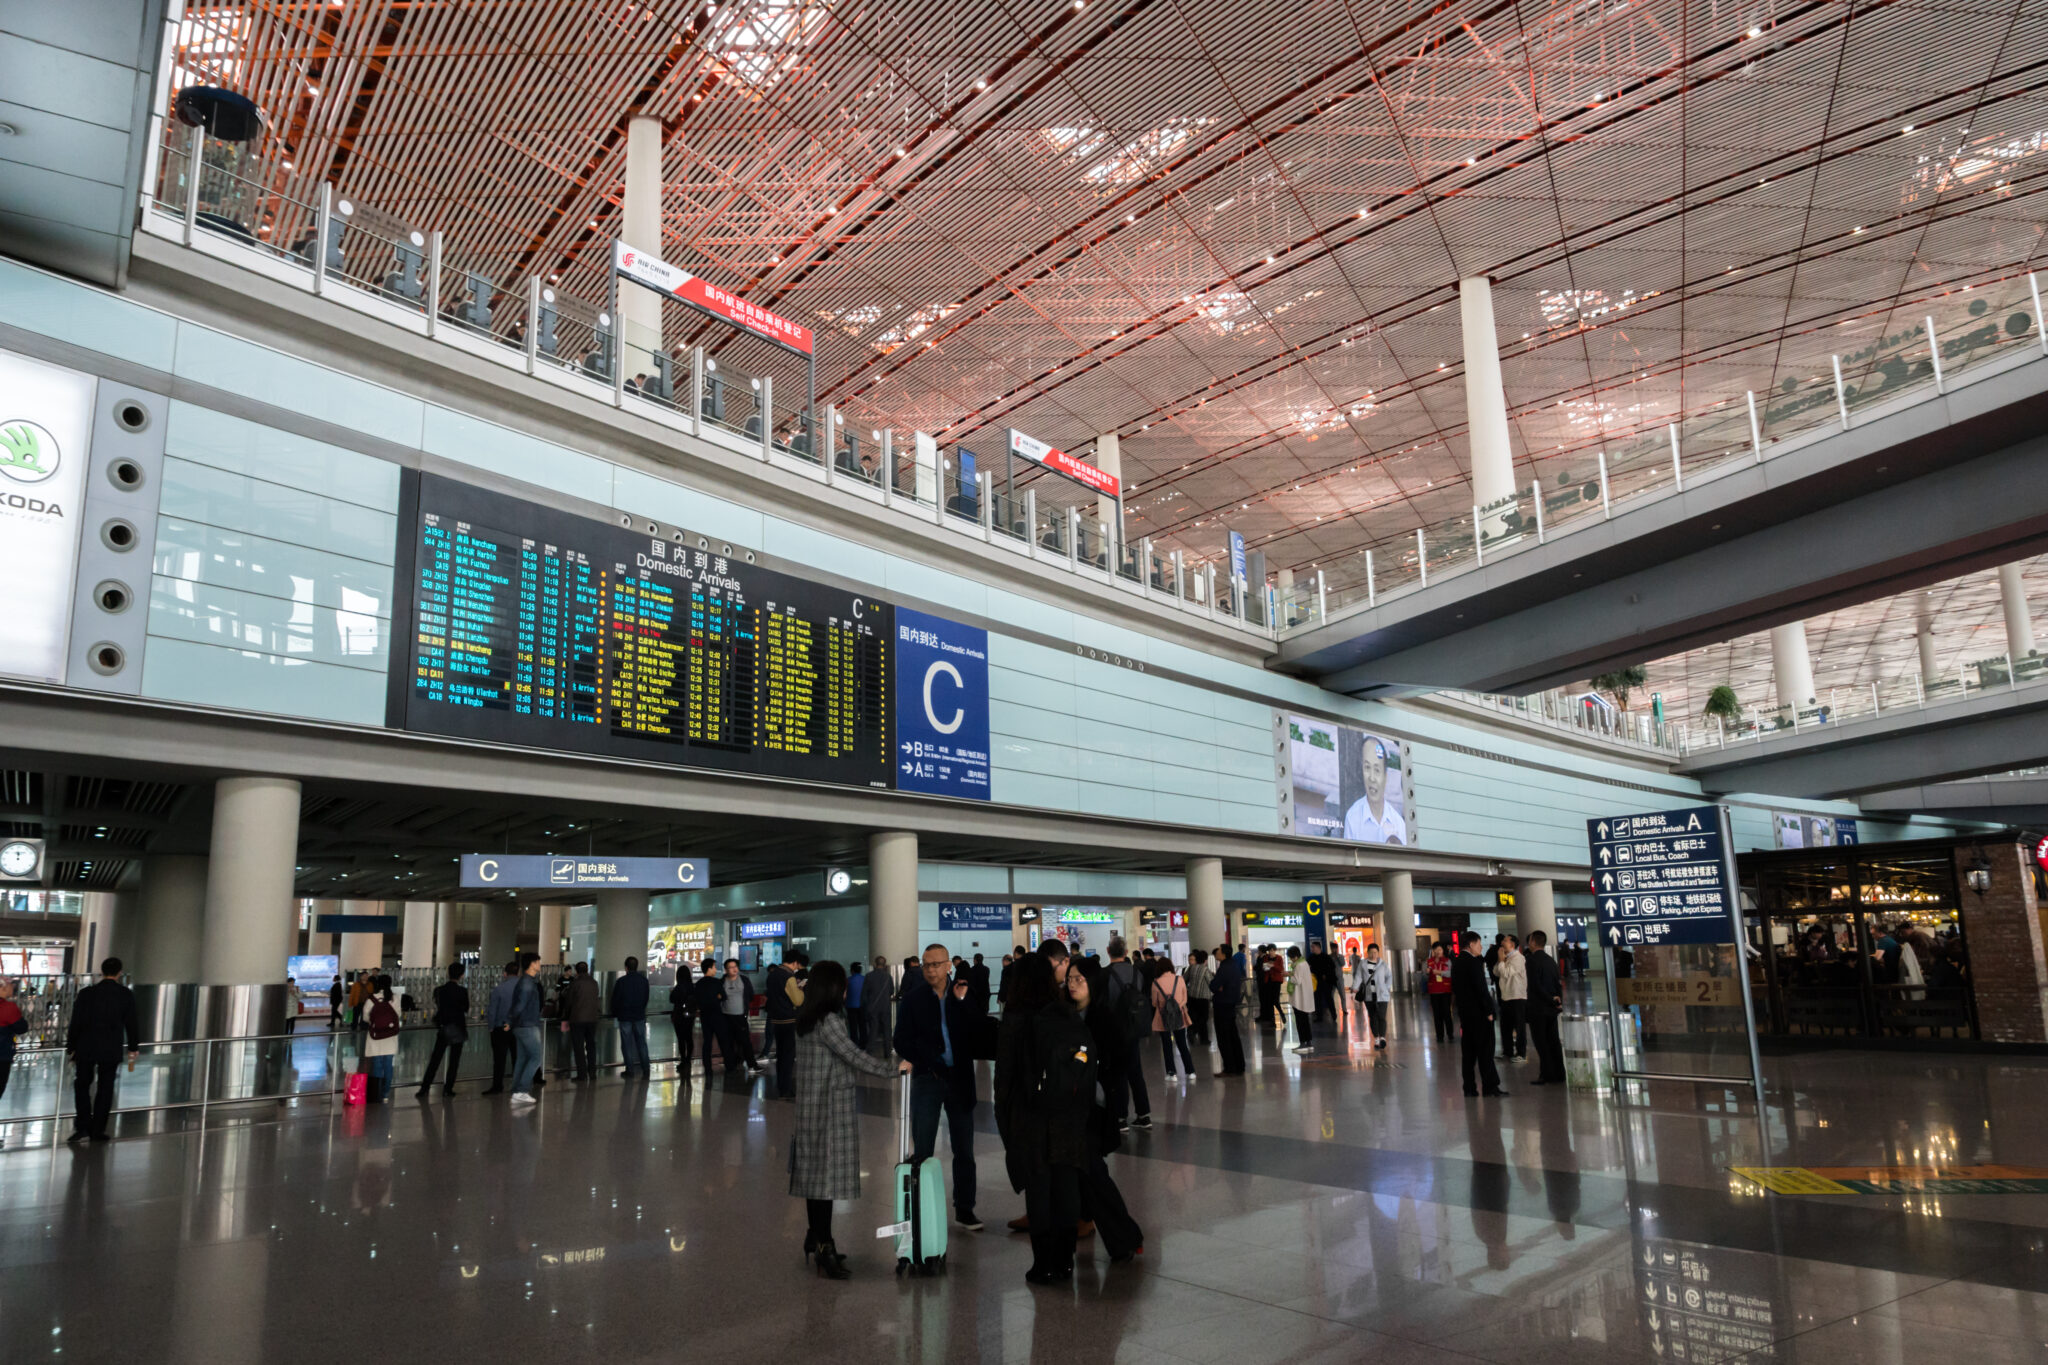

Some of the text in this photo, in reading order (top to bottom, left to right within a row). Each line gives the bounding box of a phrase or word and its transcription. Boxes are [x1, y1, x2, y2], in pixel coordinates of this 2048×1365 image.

[638, 259, 650, 269] AIR
[650, 264, 670, 279] CHINA
[705, 285, 802, 339] 国内航班自助乘机登记
[730, 309, 779, 338] Self Check-in
[470, 558, 489, 570] Fuzhou
[651, 540, 728, 574] 国内到港
[636, 553, 741, 591] Domestic Arrivals
[853, 598, 863, 619] C
[899, 625, 985, 659] 国内到达 Domestic Arrivals
[923, 660, 964, 735] C
[914, 741, 923, 757] B
[914, 762, 924, 777] A
[1632, 813, 1702, 831] 国内到达 A
[1633, 825, 1685, 836] Domestic Arrivals
[1634, 839, 1707, 854] 市内巴士、省际巴士
[1635, 852, 1689, 863] Local Bus, Coach
[479, 860, 499, 881] C
[578, 863, 617, 875] 国内到达
[677, 863, 695, 883] C
[1306, 899, 1320, 916] C
[1682, 906, 1701, 914] Airport
[1701, 905, 1723, 914] Express
[1645, 924, 1670, 934] 出租车
[1645, 935, 1659, 943] Taxi
[1697, 981, 1711, 1002] 2
